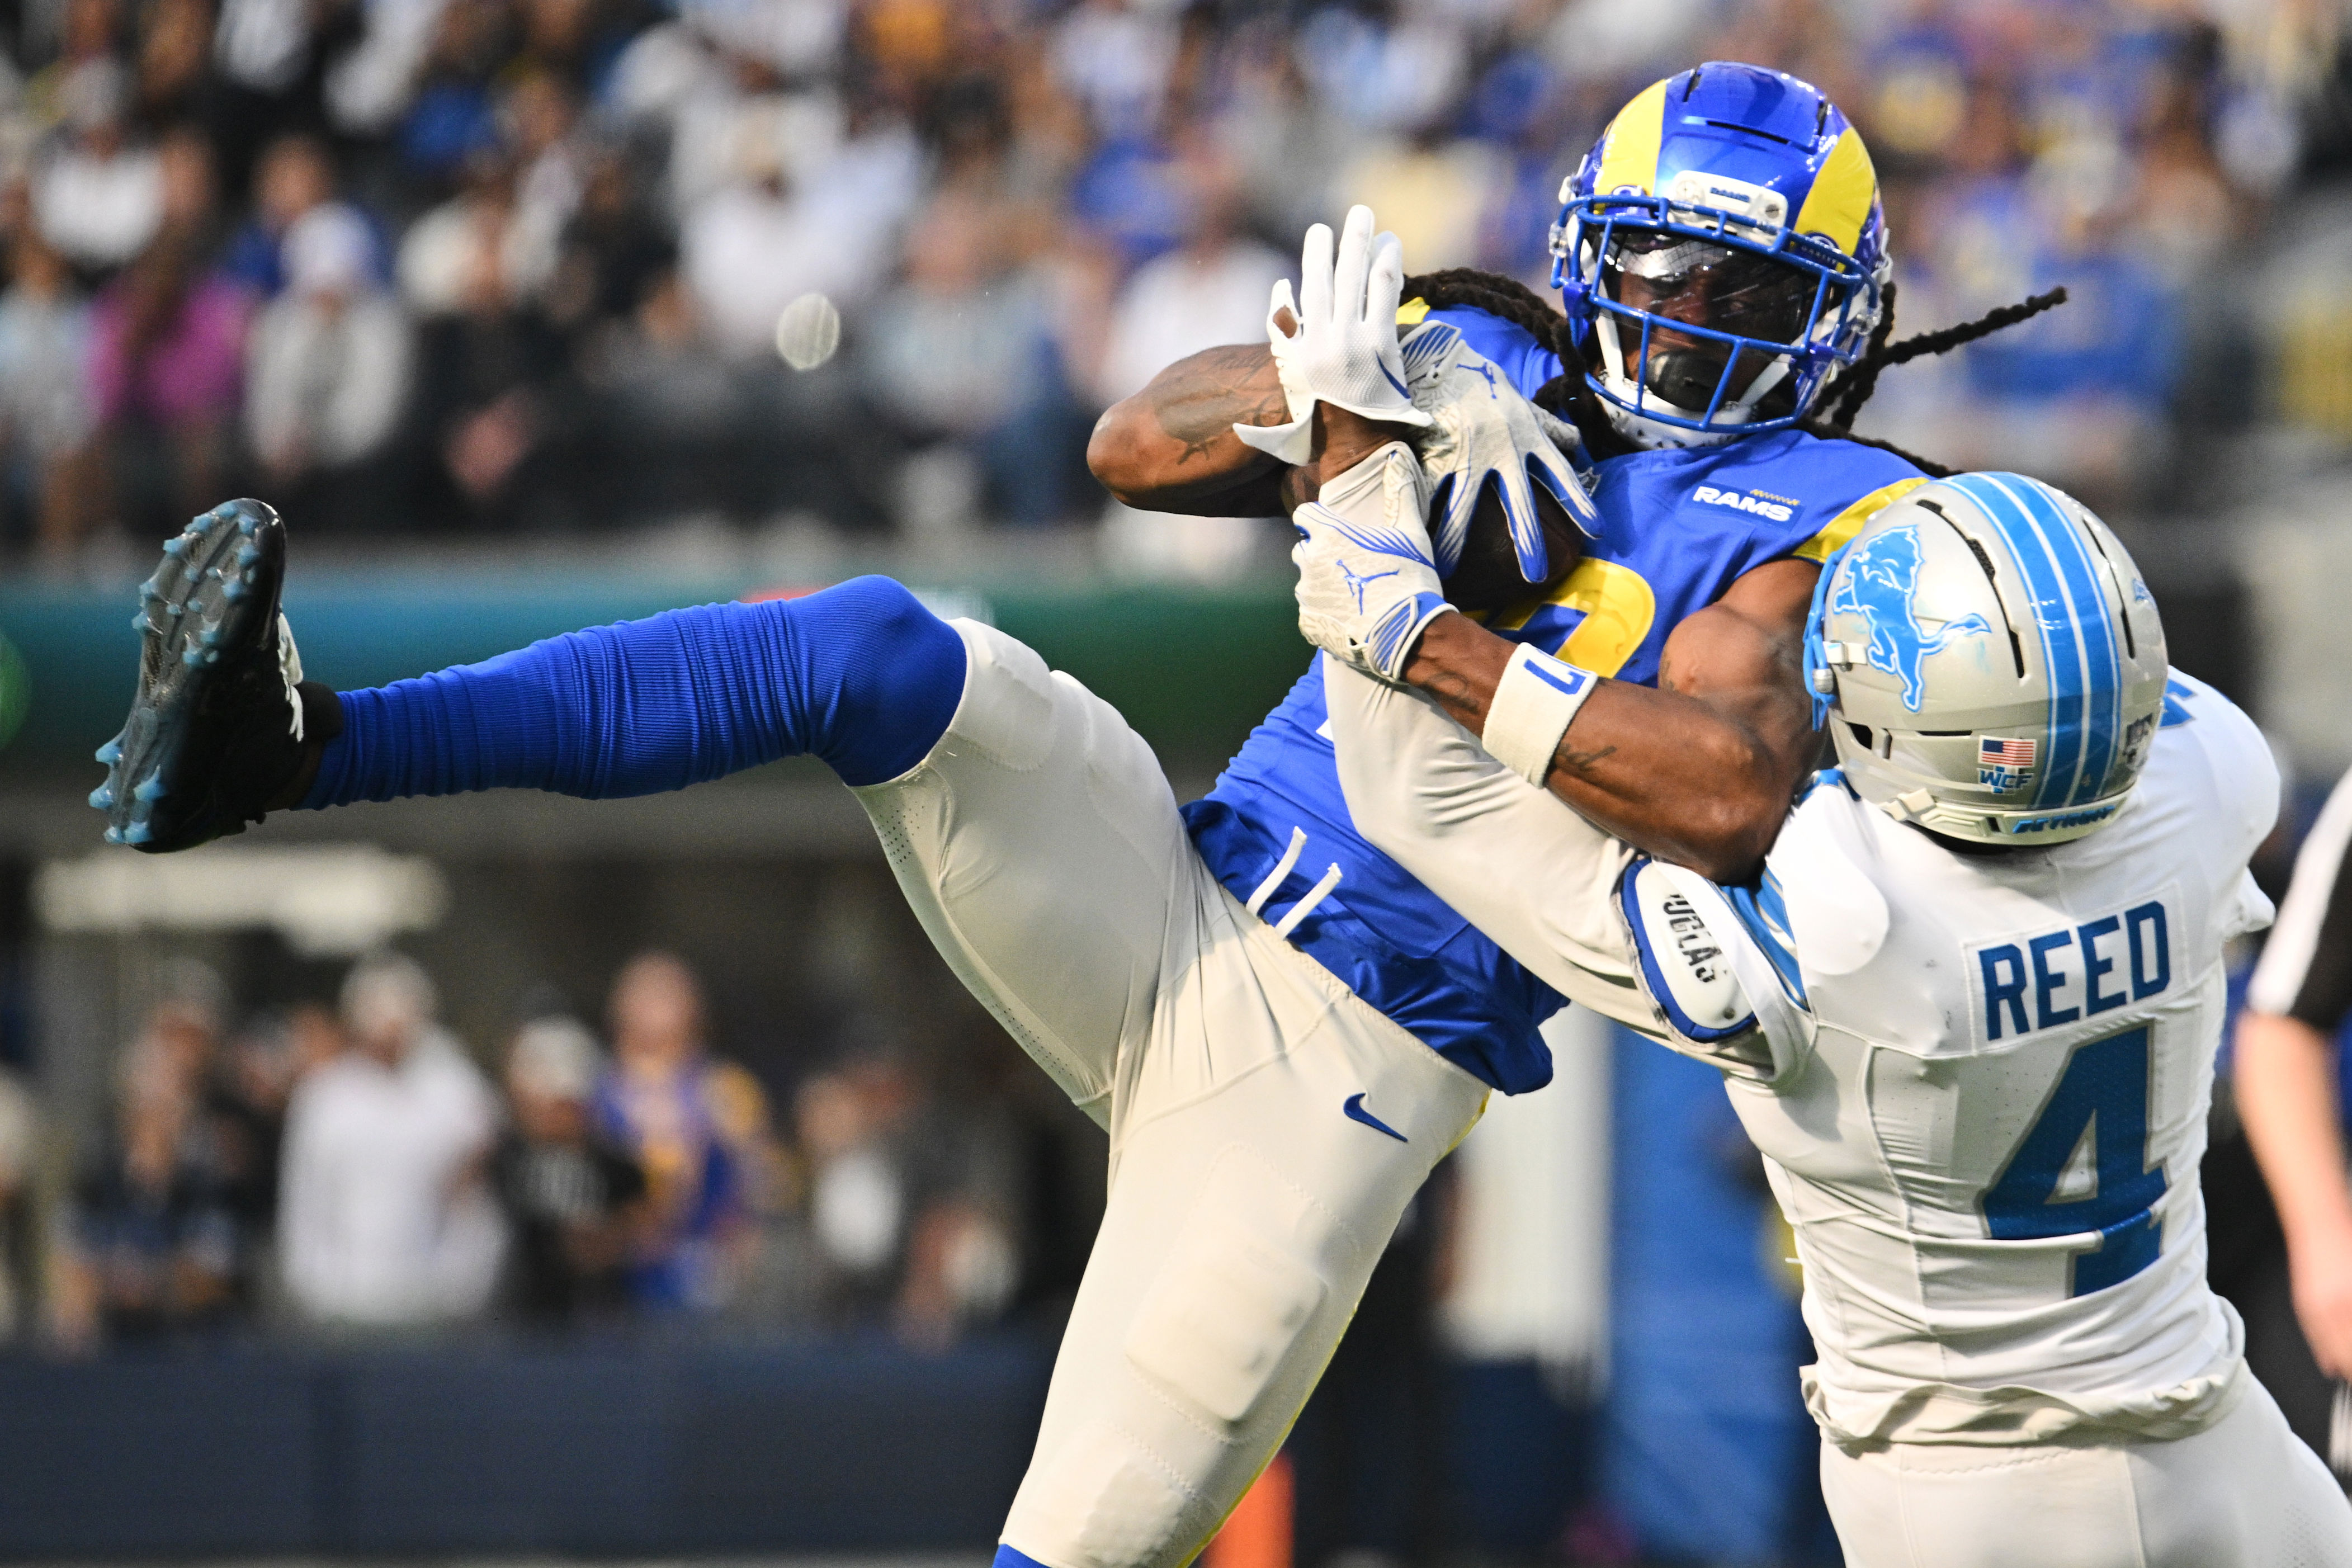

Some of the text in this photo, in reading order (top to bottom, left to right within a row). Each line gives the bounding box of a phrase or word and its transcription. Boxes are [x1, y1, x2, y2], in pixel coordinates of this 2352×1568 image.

[1693, 486, 1793, 522] RAMS
[1978, 769, 2033, 789] WCF
[1978, 901, 2171, 1041] REED
[1974, 1018, 2171, 1300] 4
